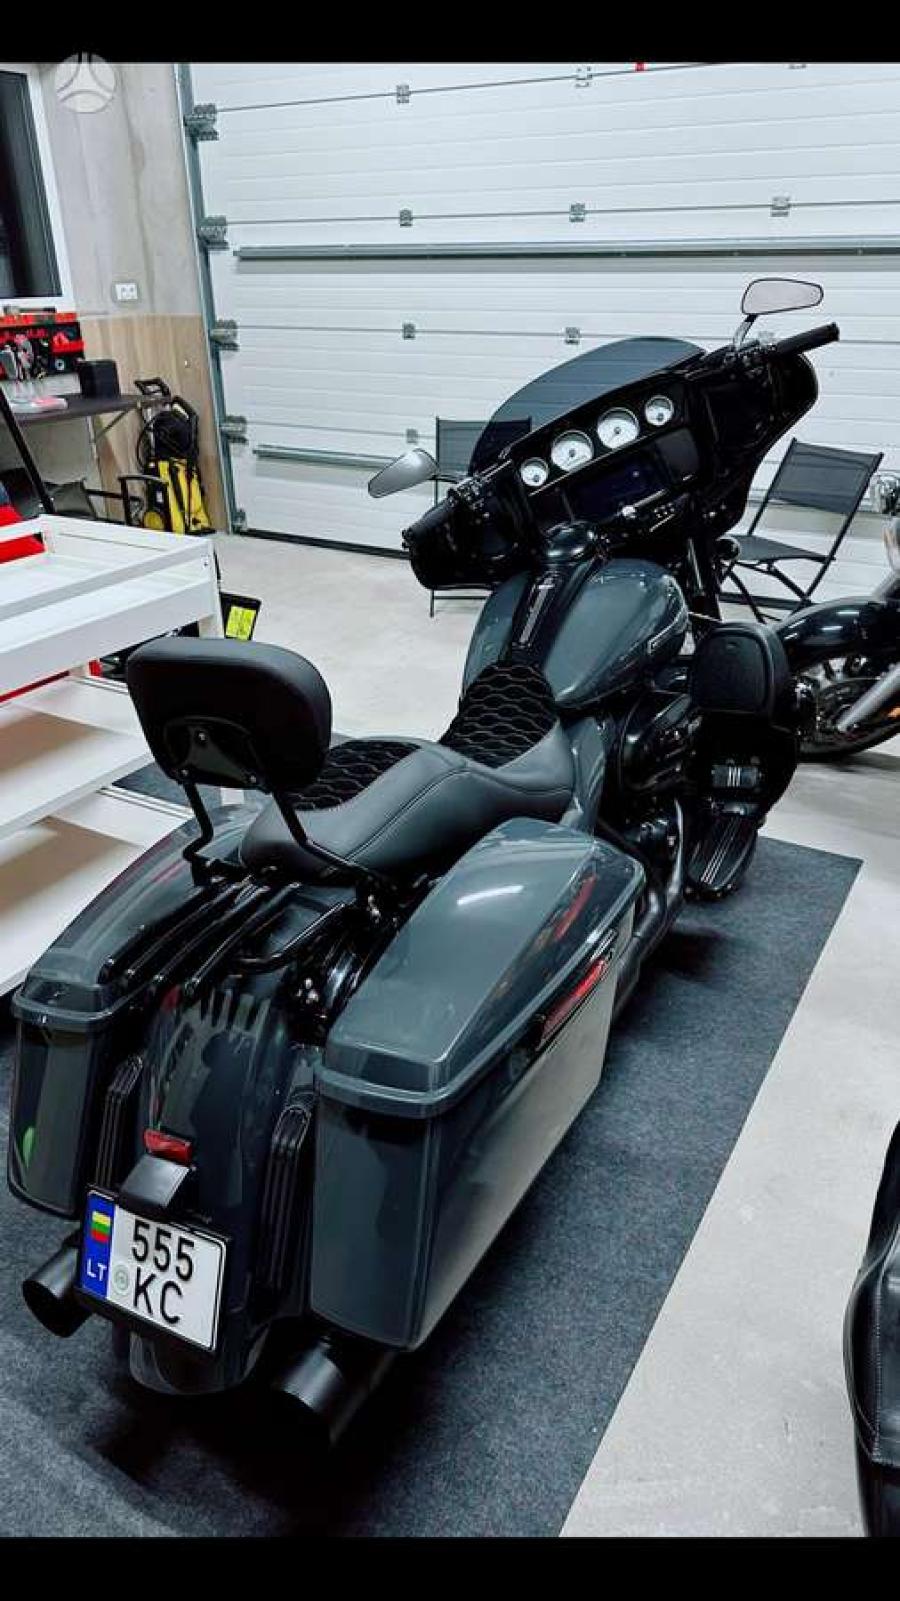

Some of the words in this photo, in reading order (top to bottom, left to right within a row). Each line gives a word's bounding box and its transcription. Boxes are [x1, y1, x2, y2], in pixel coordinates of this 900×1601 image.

[86, 1258, 107, 1281] LT
[132, 1220, 195, 1282] 555
[134, 1266, 183, 1324] KC
